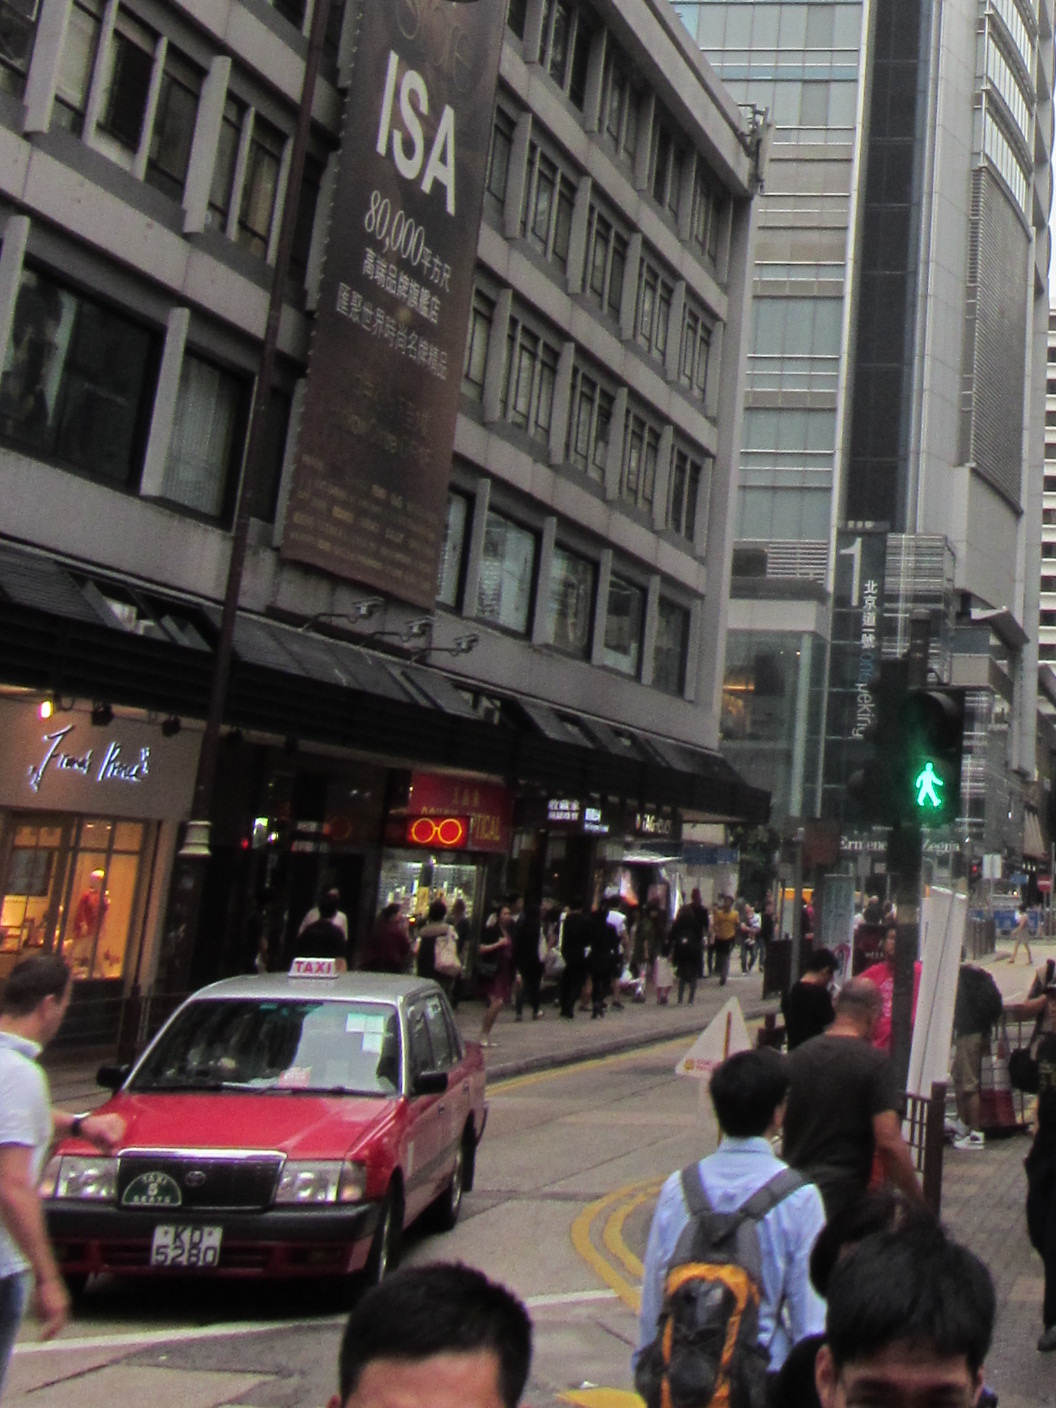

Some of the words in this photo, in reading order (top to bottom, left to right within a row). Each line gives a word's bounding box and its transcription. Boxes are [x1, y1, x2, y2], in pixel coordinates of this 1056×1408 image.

[376, 50, 456, 217] ISA
[839, 537, 862, 606] 1
[295, 961, 332, 974] TAXI
[154, 1245, 218, 1266] 5280
